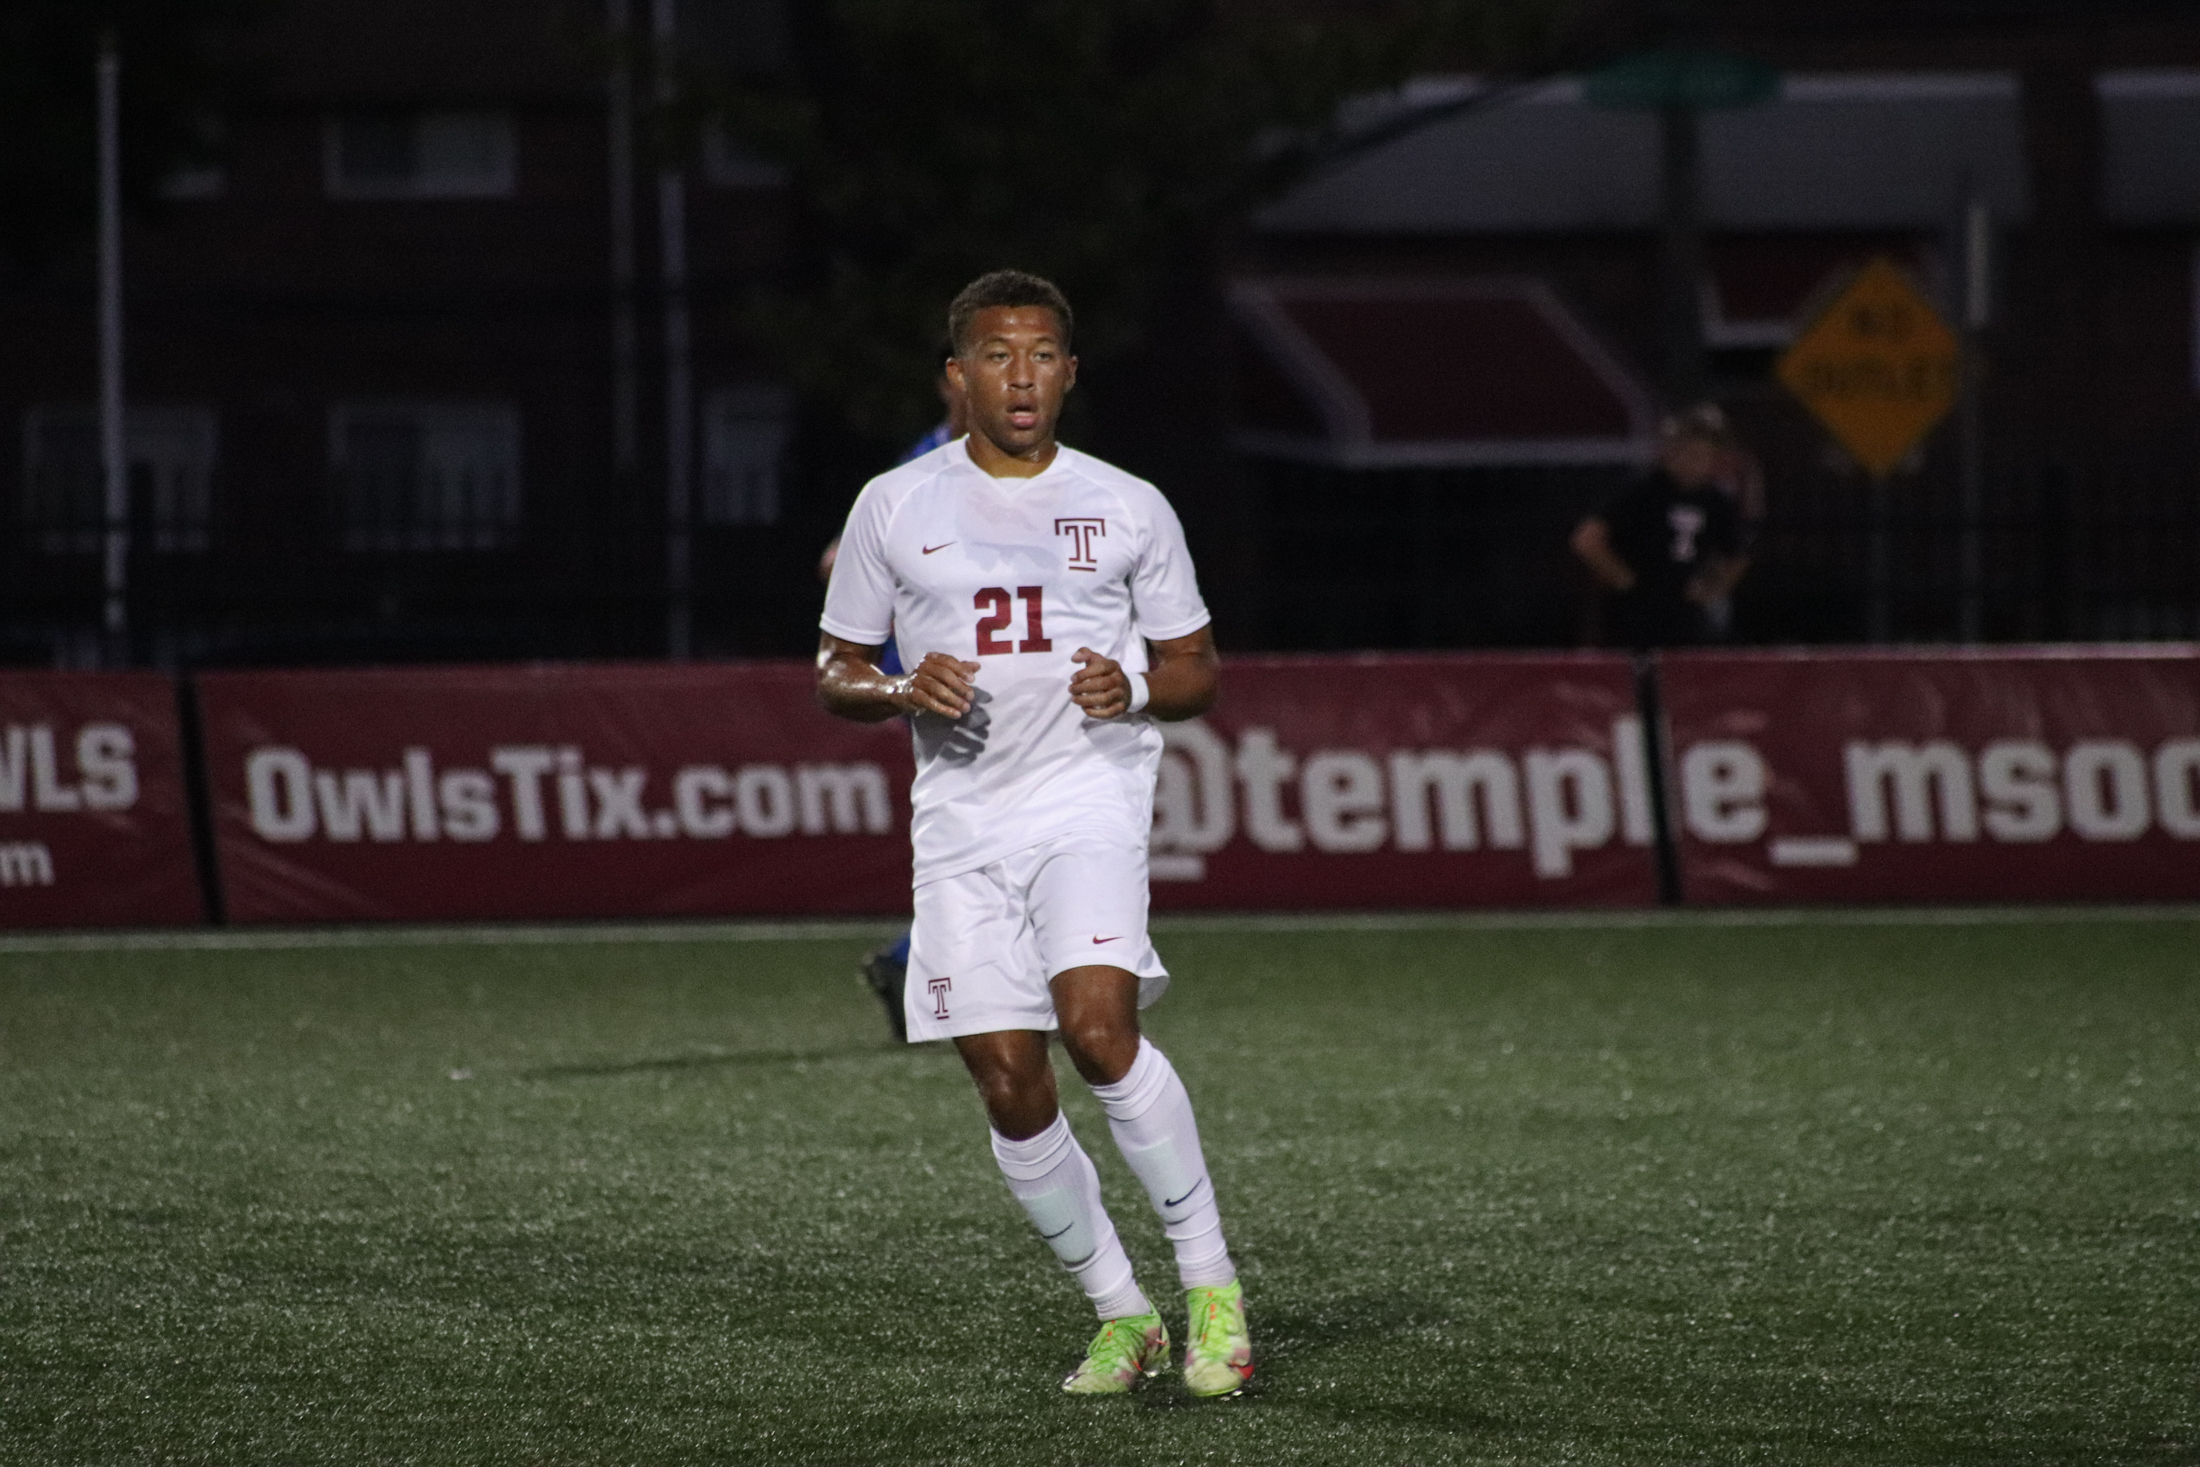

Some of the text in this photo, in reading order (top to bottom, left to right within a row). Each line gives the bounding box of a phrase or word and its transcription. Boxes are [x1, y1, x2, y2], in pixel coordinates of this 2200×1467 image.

[1054, 518, 1106, 572] T
[974, 586, 1053, 656] 21
[246, 746, 893, 843] OwlsTix.com
[928, 976, 952, 1020] T
